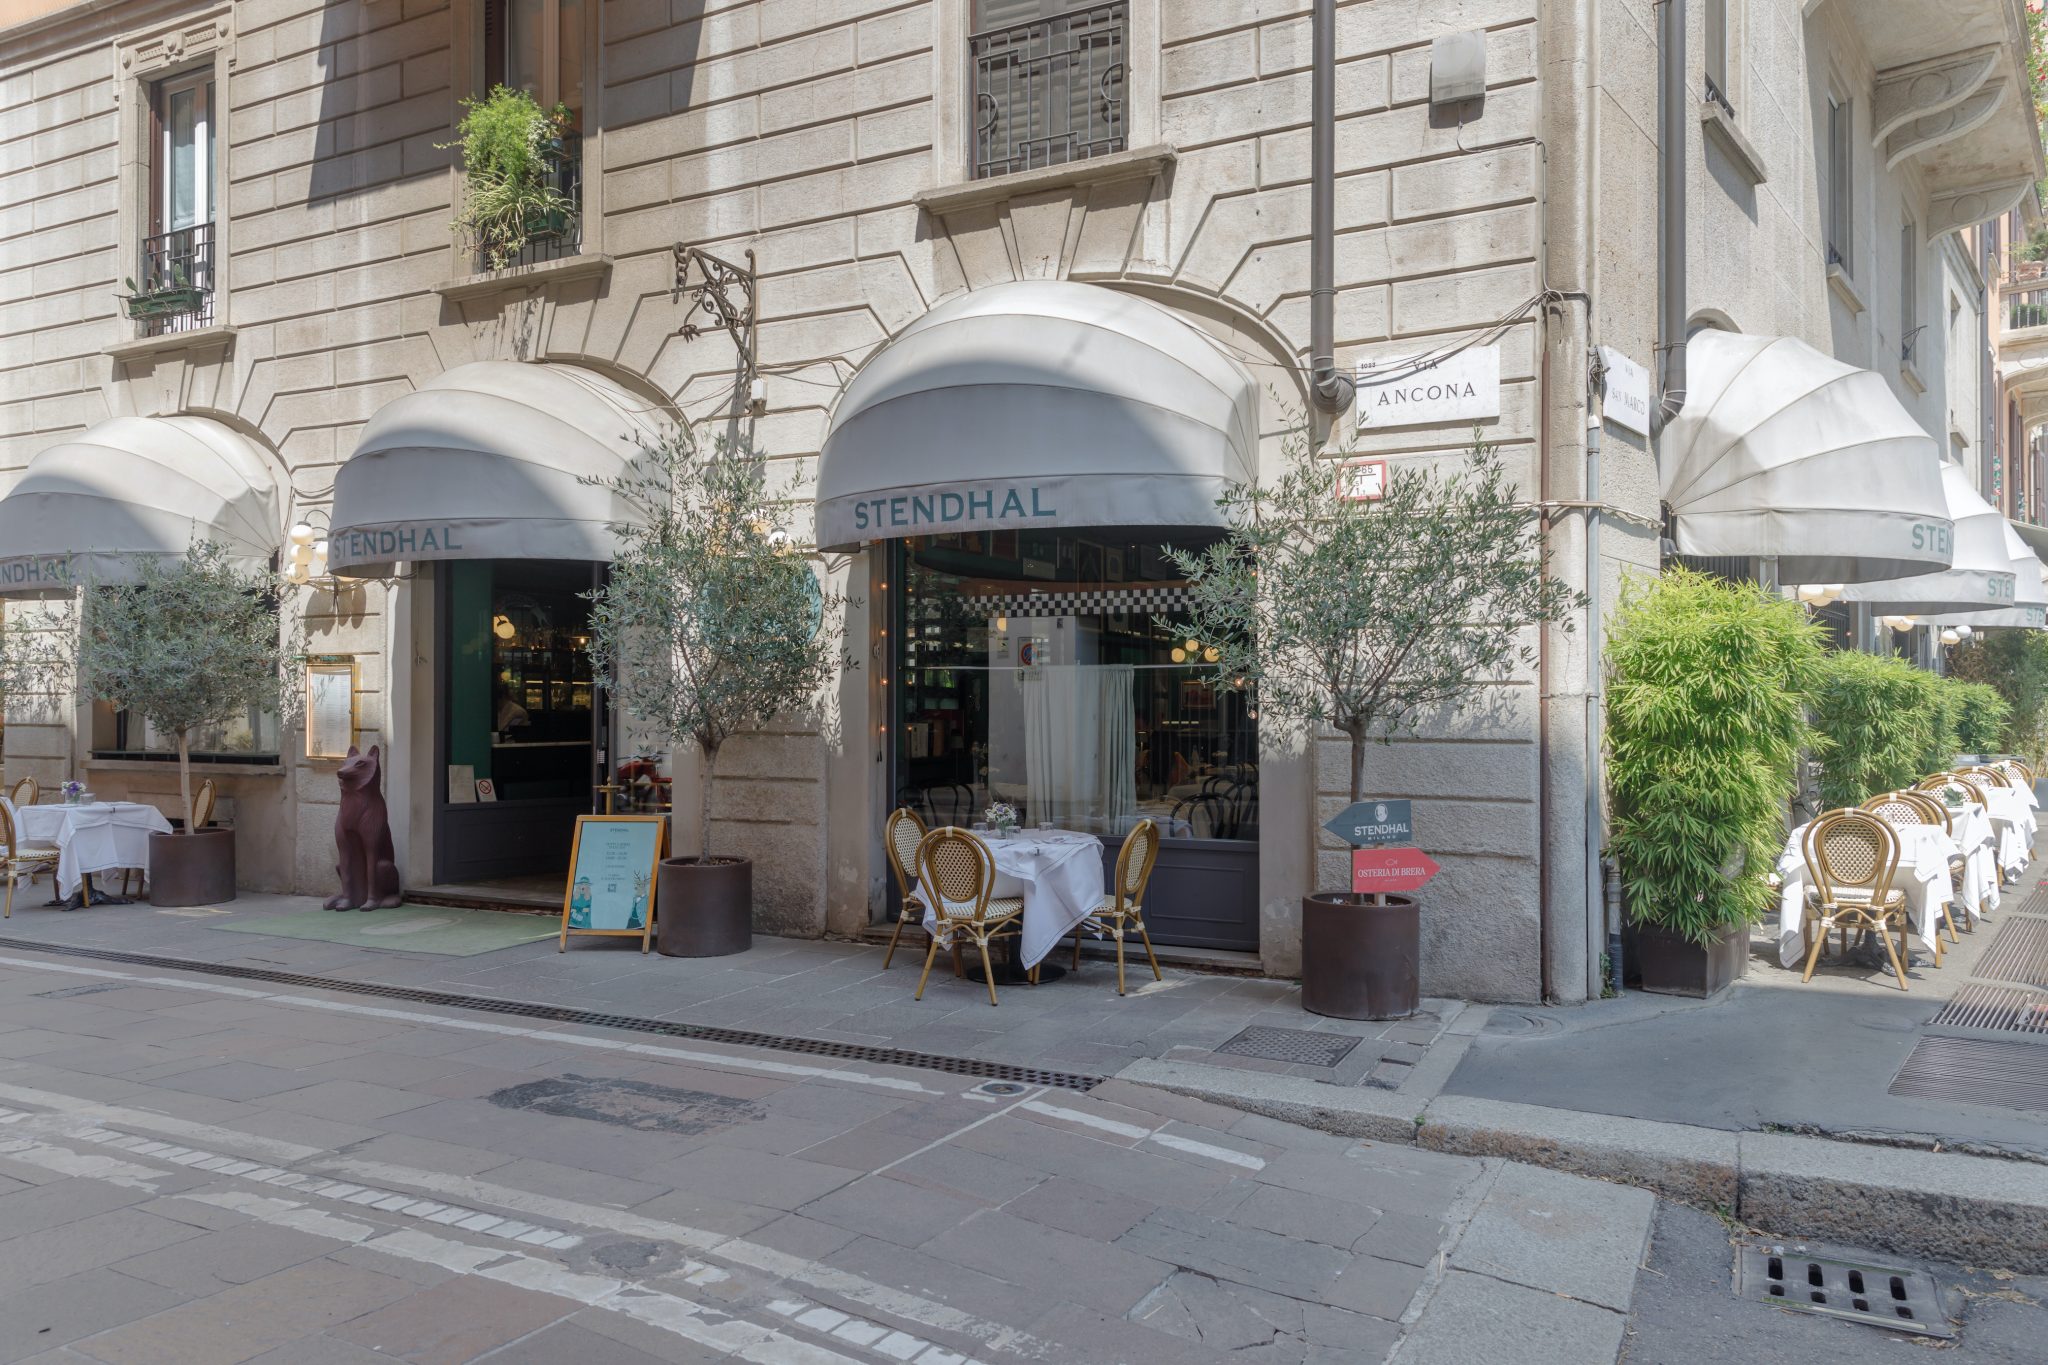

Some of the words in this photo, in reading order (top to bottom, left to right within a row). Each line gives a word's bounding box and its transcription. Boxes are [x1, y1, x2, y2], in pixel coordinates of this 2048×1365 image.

[1413, 360, 1439, 371] VIA
[1377, 381, 1477, 406] ANCONA
[854, 487, 1057, 530] STENDHAL
[334, 527, 463, 559] STENDHAL
[0, 561, 76, 584] NDHAL
[1354, 823, 1409, 836] STENDHAL
[1358, 868, 1391, 878] OSTERIA
[1392, 868, 1400, 877] DI
[1401, 867, 1426, 876] BRERA
